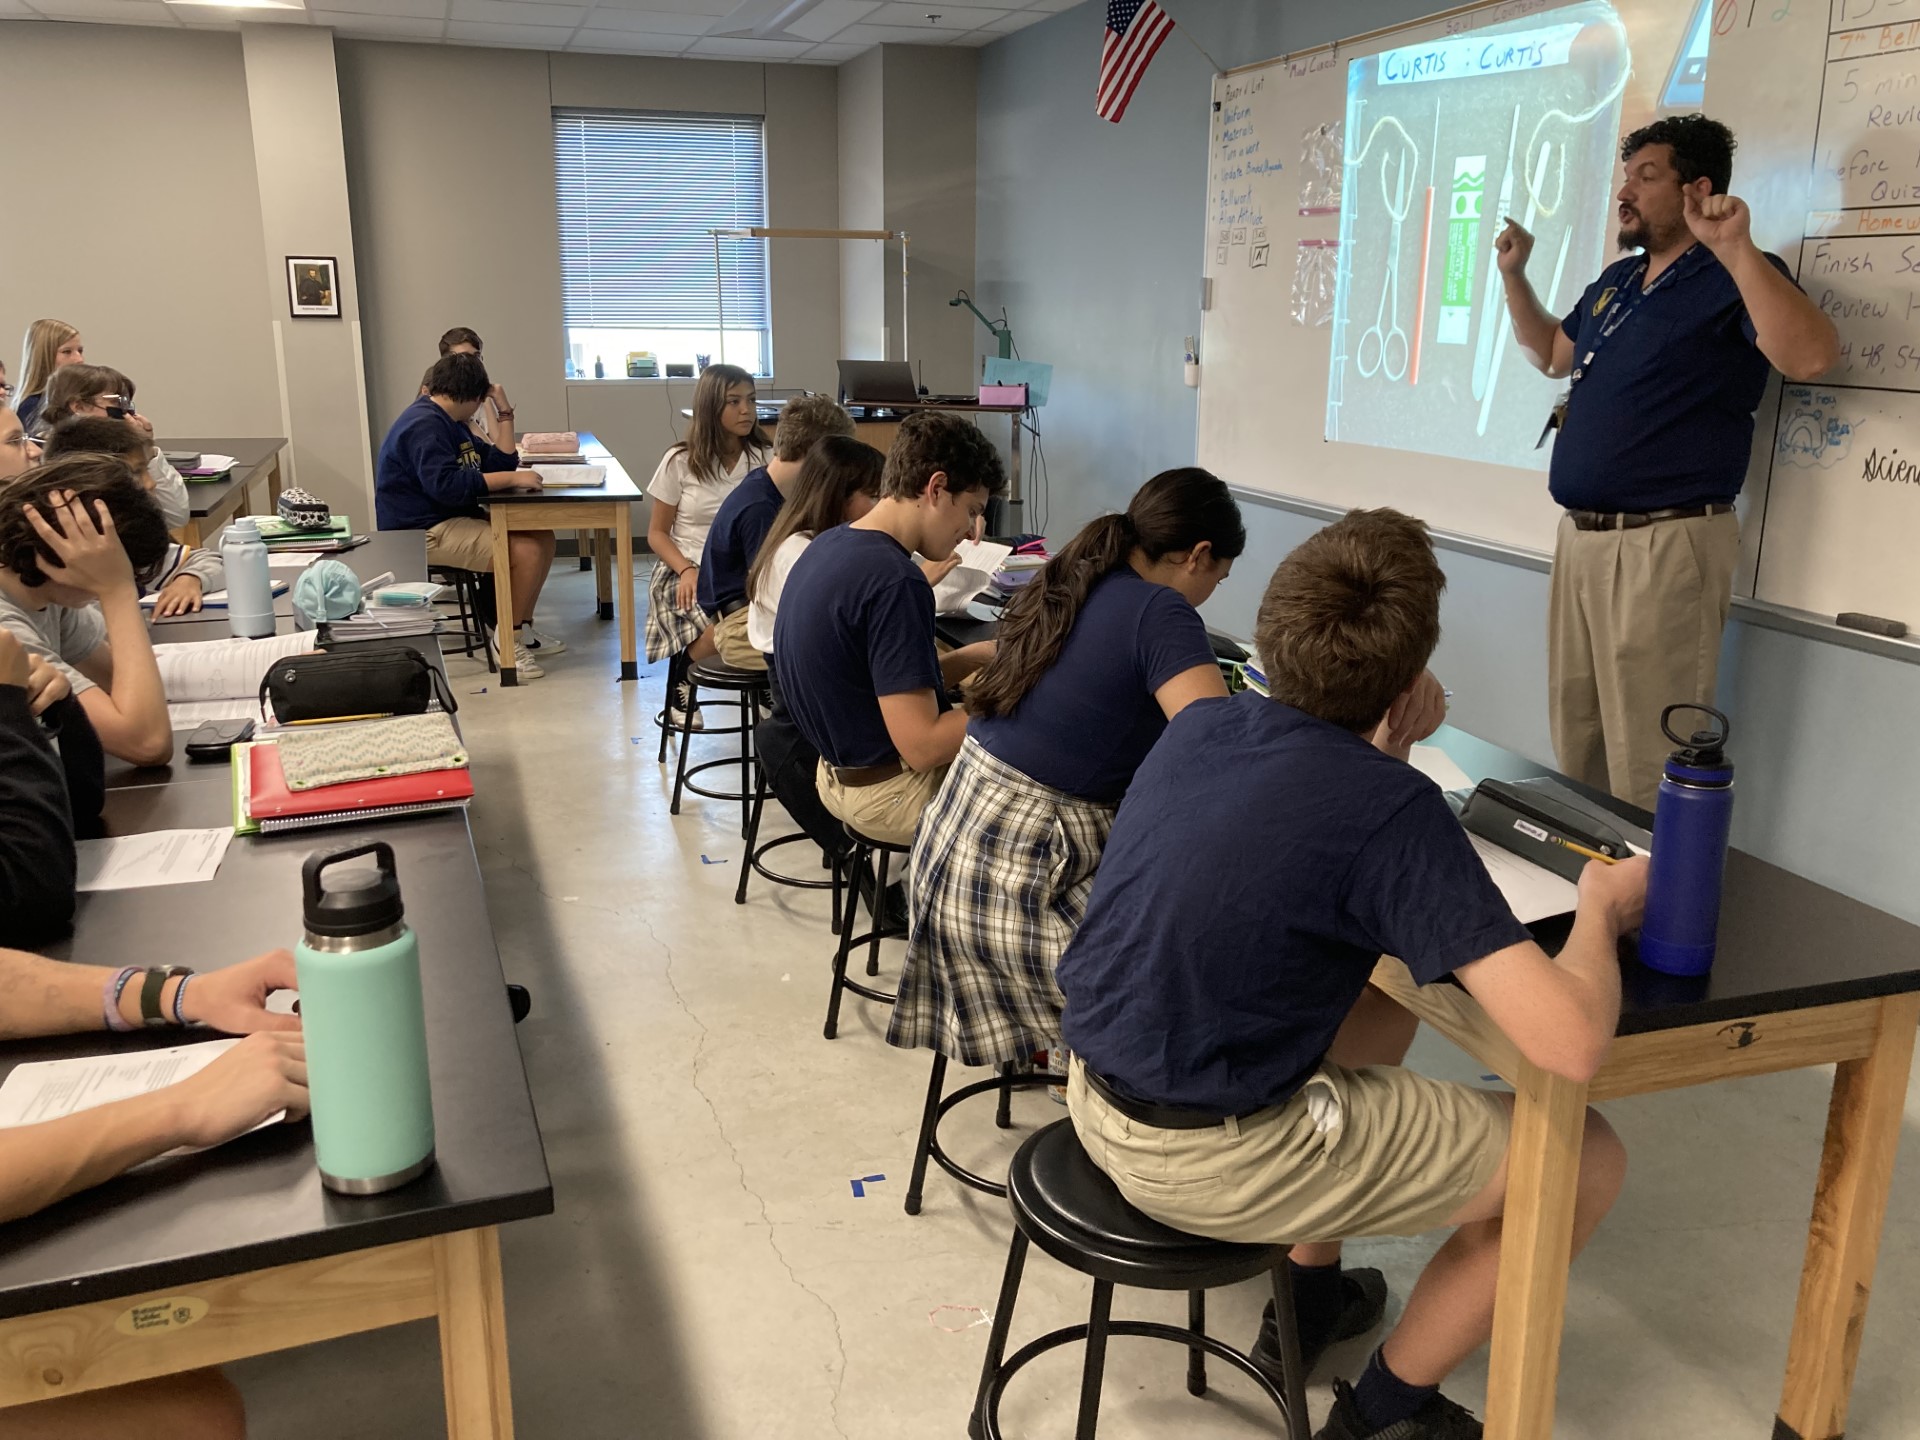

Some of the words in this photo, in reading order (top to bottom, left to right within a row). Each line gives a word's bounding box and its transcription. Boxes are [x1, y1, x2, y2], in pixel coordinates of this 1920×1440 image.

[1385, 51, 1447, 81] CURTIS
[1838, 68, 1860, 104] 5
[1810, 242, 1874, 276] Finish
[1819, 289, 1889, 320] Review
